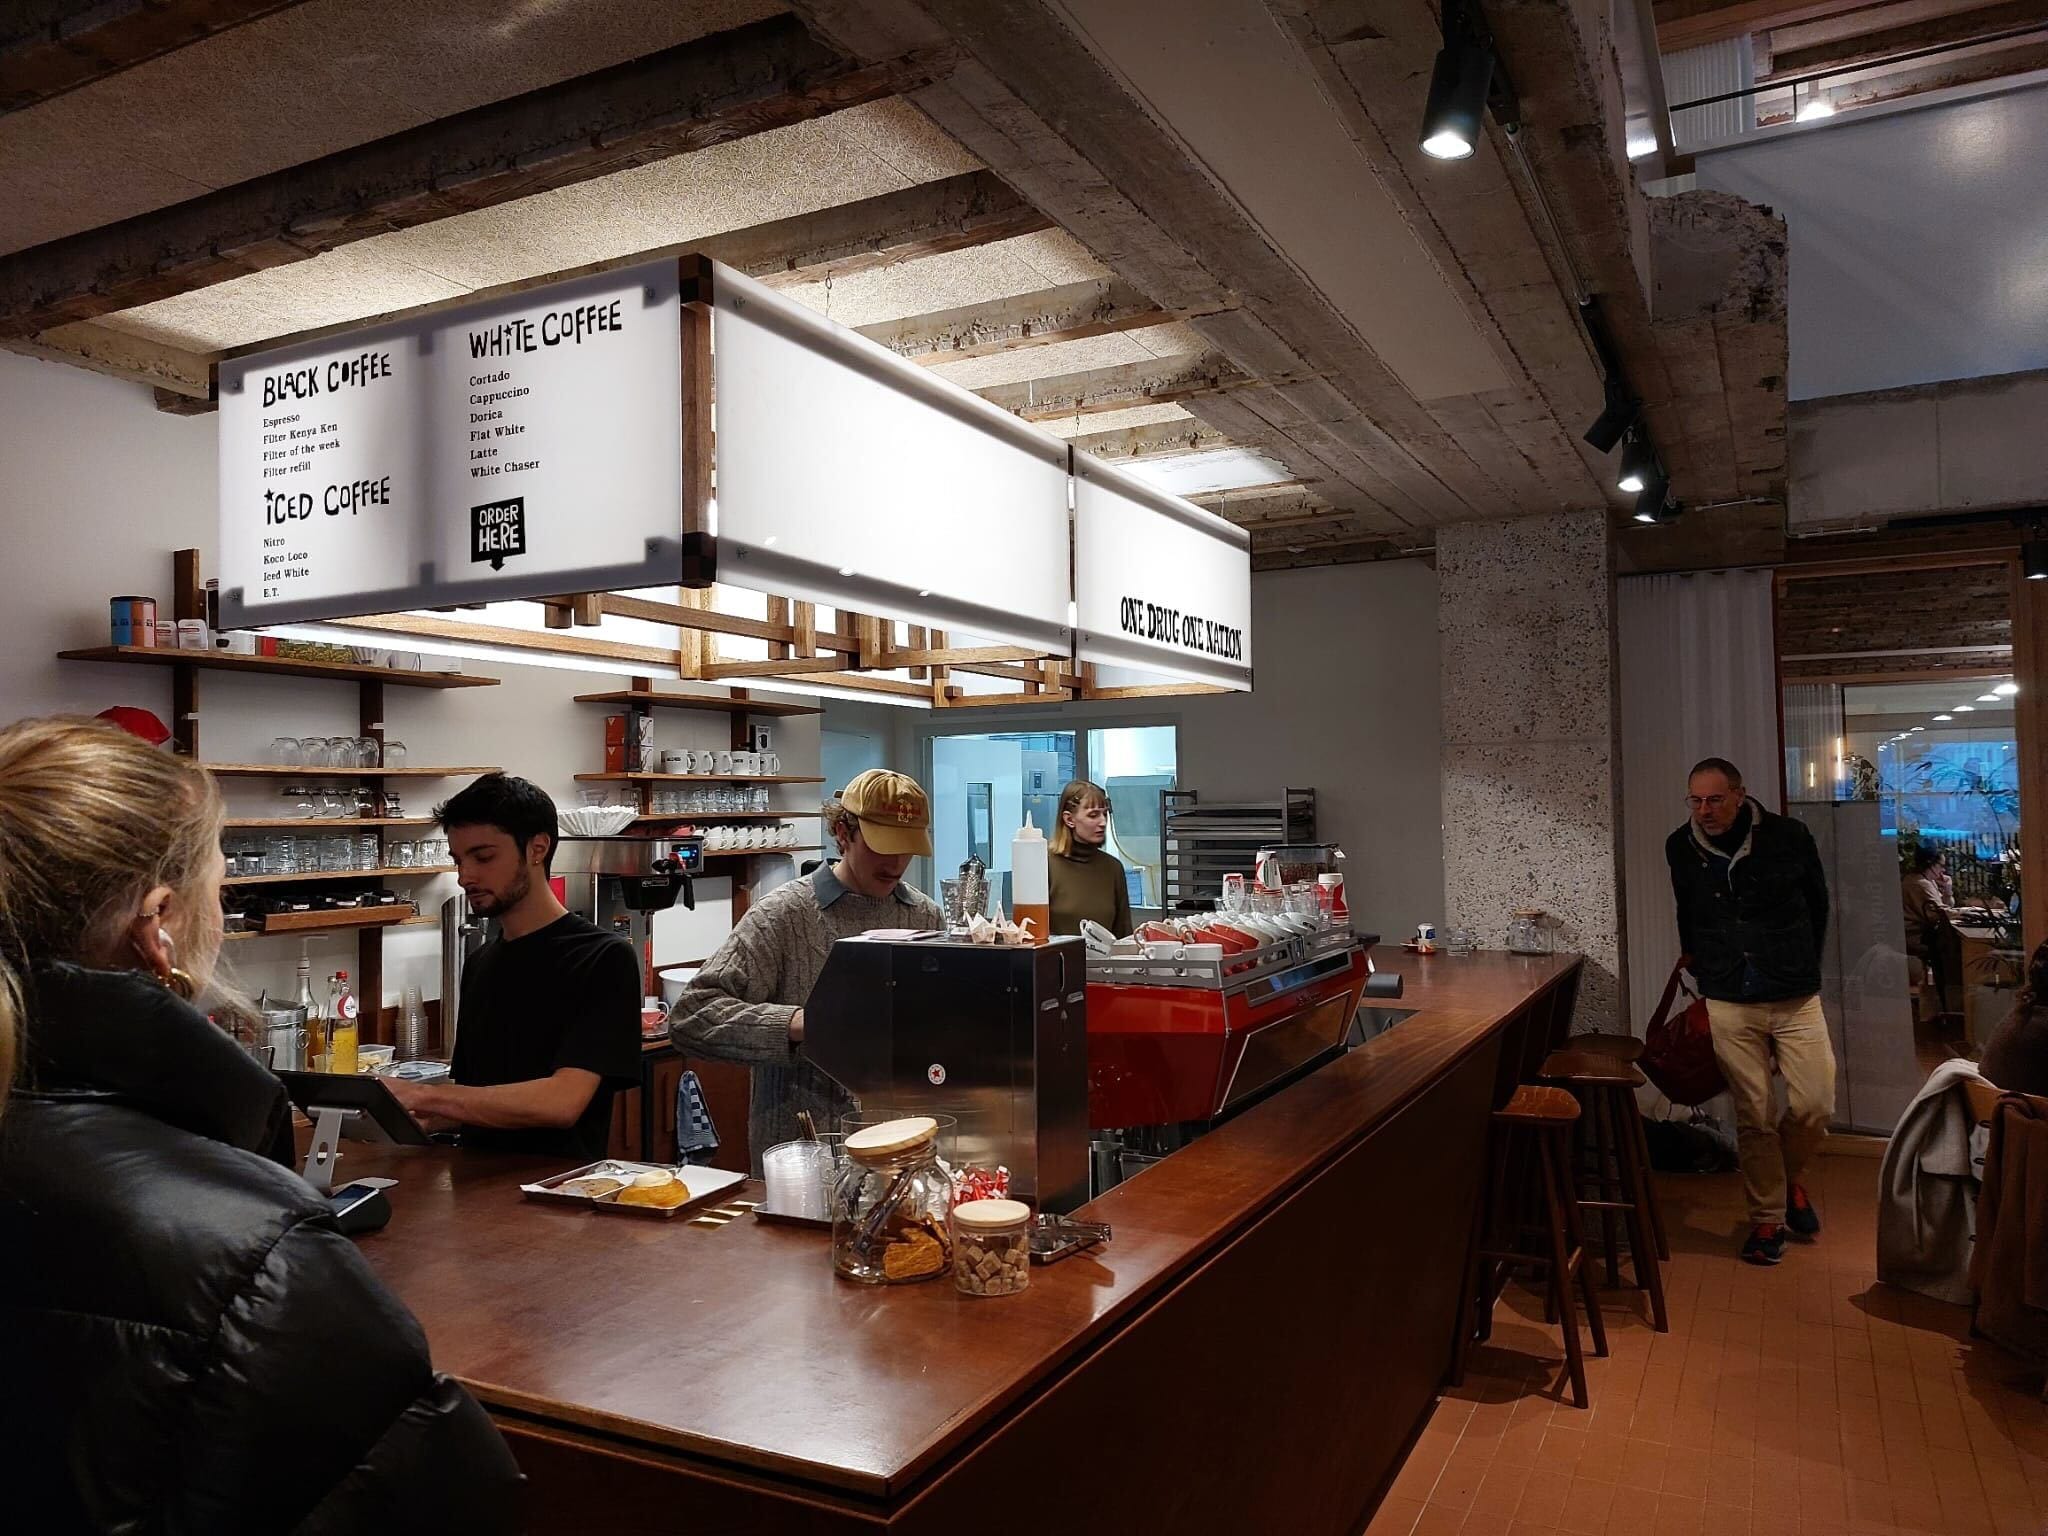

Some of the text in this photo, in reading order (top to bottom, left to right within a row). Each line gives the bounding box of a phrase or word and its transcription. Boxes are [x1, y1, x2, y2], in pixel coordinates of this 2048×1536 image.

[542, 300, 622, 346] COFFEE
[263, 352, 392, 407] BLACK COFFEE
[469, 371, 510, 386] Cortado
[469, 386, 530, 405] Cappuccino
[263, 413, 300, 428] Espresso
[470, 409, 503, 423] Dorica
[263, 422, 338, 444] Filter Kenya Ken
[470, 424, 525, 441] Flat White
[263, 439, 341, 461] Filter of the week
[470, 447, 498, 460] Latte
[263, 461, 311, 478] Filter refill
[471, 458, 540, 479] White Chaser
[324, 476, 390, 516] COFFEE
[479, 504, 519, 526] ORDER
[263, 537, 285, 548] Nitro
[478, 523, 520, 552] HERE
[263, 551, 308, 565] Koco Loco
[263, 567, 310, 582] Iced White
[263, 588, 279, 598] E.T.
[1120, 596, 1242, 661] ONE DRUG ONE NATION
